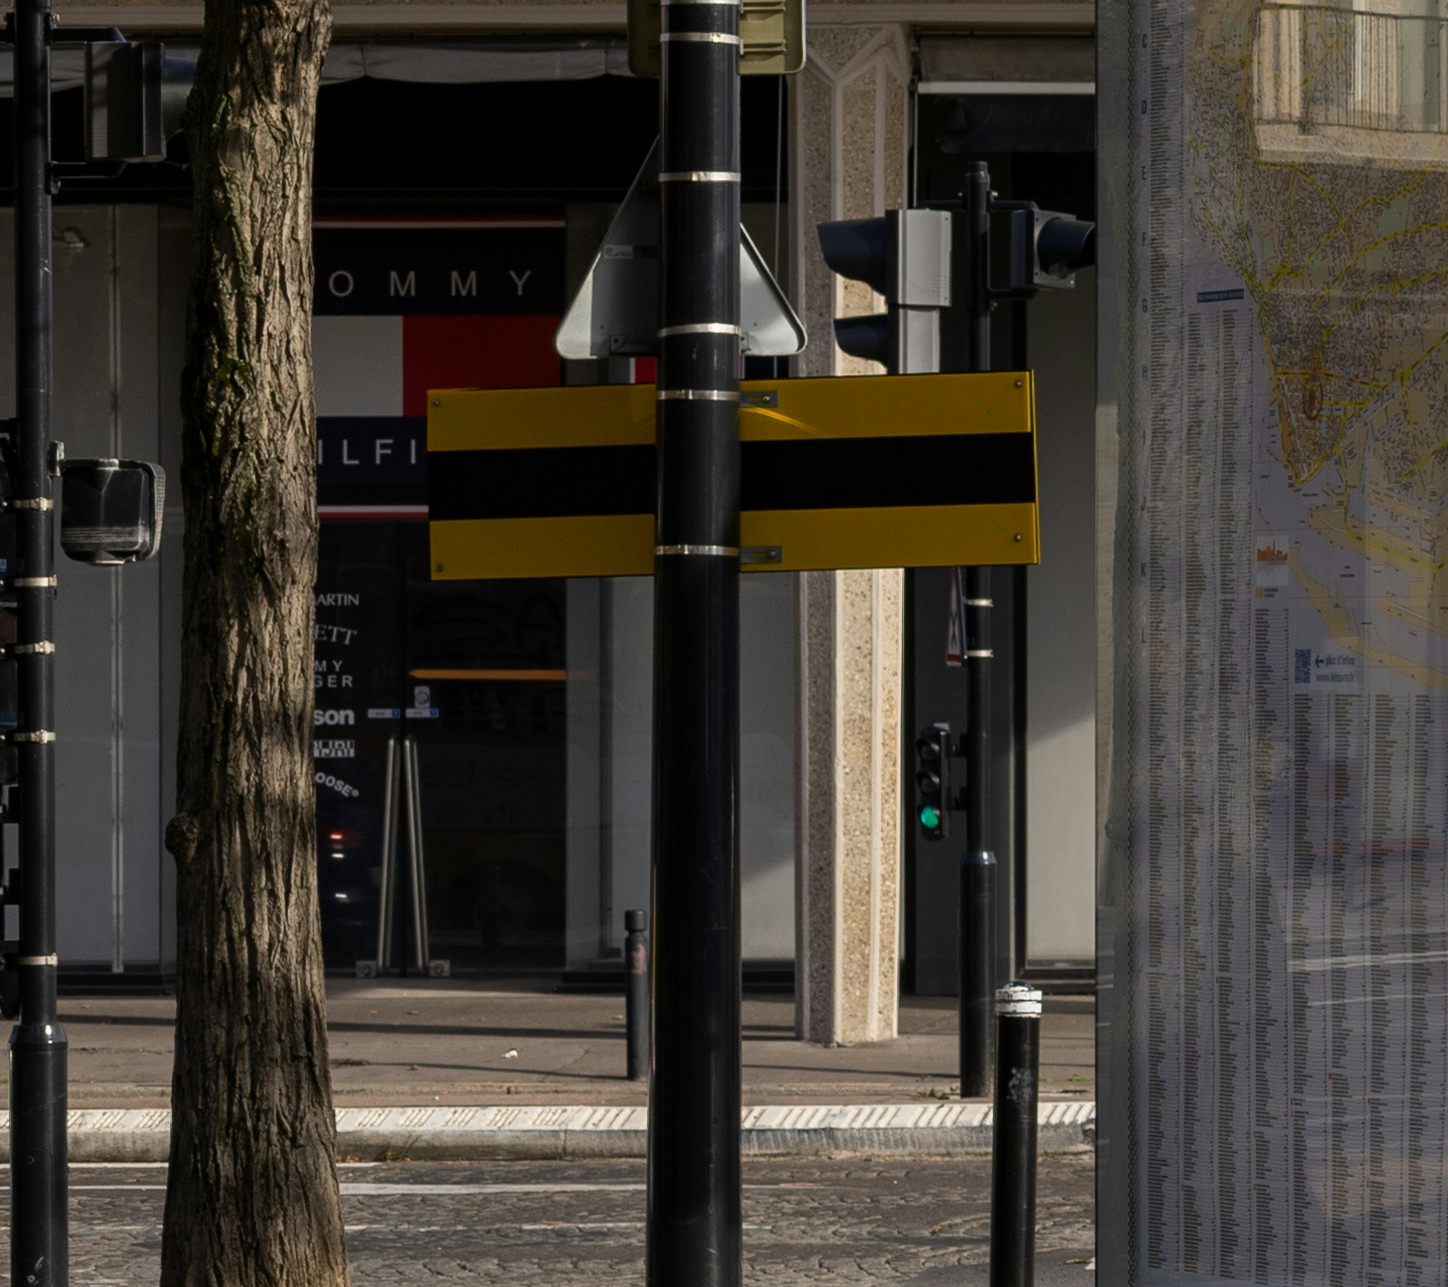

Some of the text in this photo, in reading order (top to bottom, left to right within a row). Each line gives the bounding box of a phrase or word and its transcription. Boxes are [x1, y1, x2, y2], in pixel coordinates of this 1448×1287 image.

[329, 270, 531, 297] OMMY
[317, 438, 418, 465] ILFI
[315, 594, 360, 606] ARTIN
